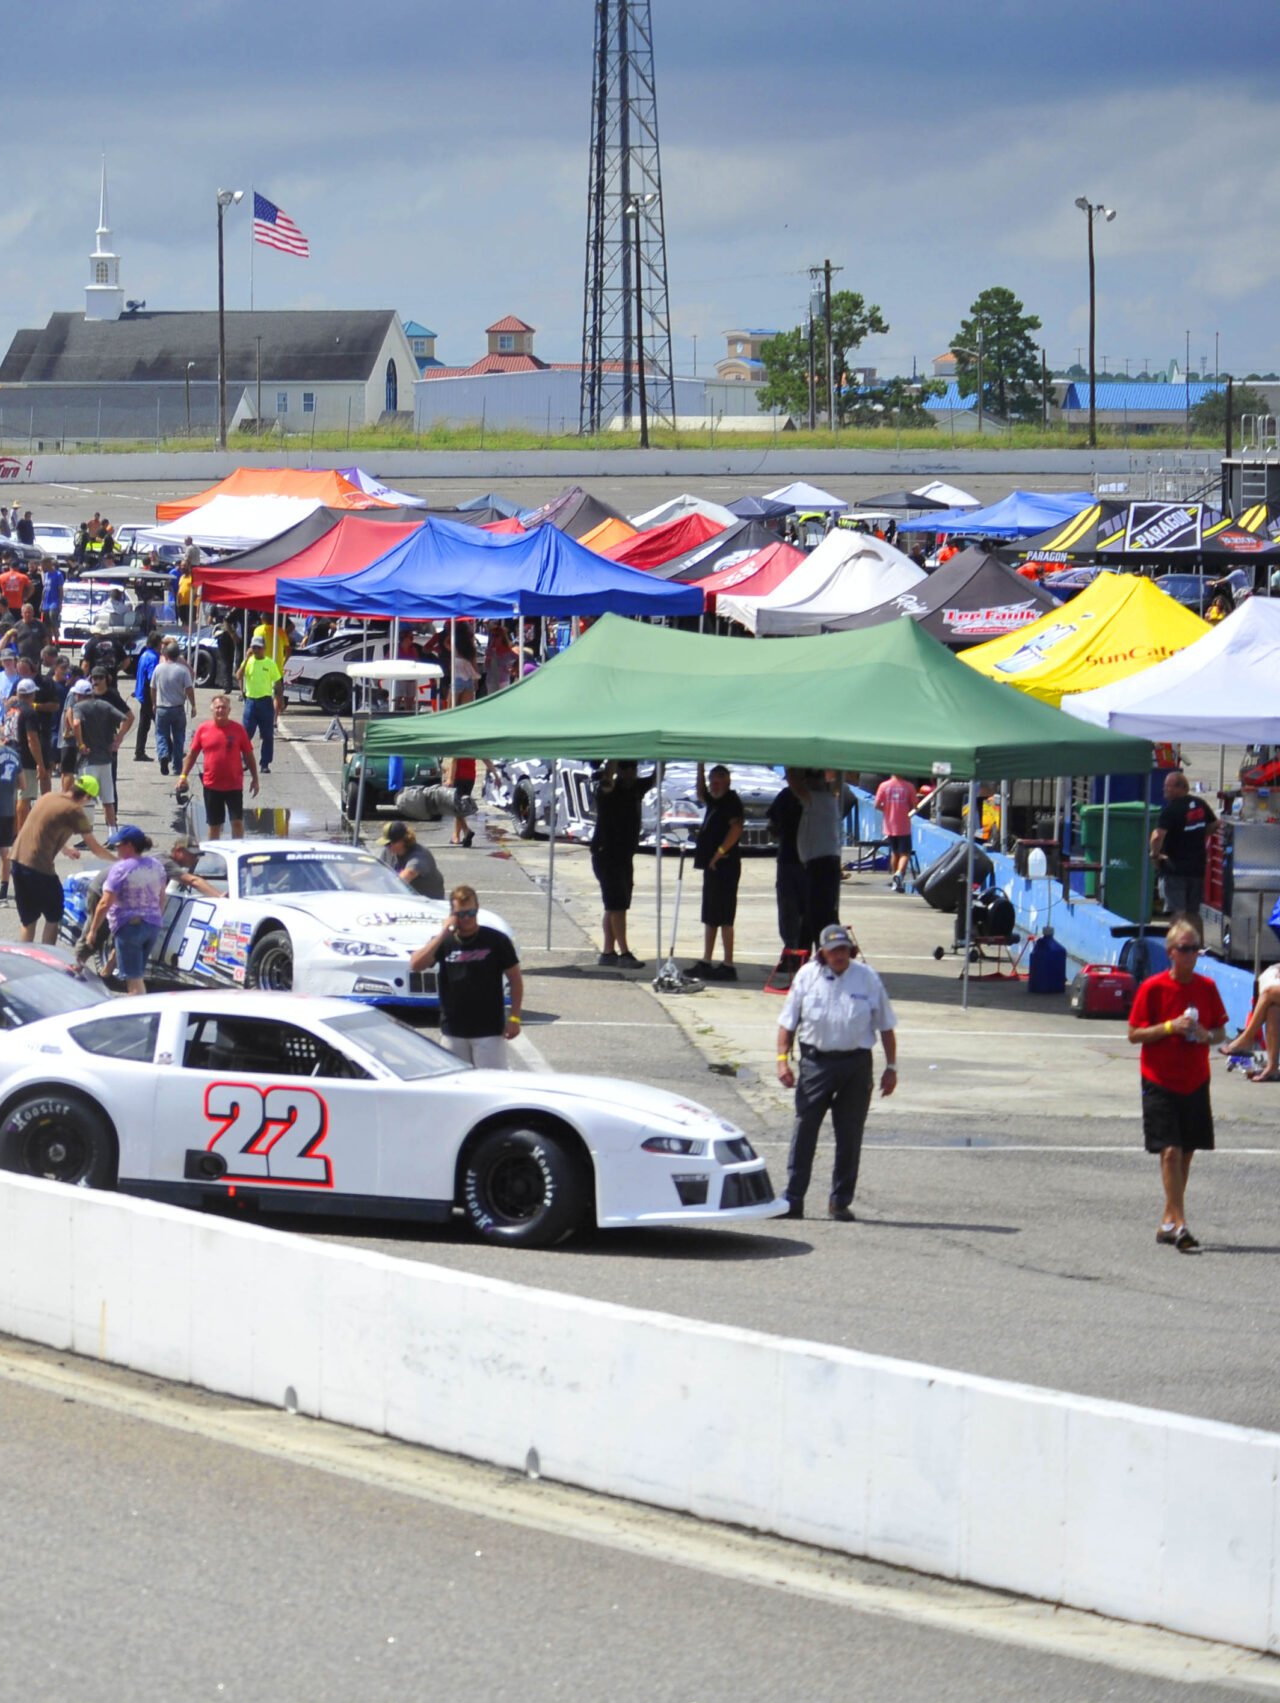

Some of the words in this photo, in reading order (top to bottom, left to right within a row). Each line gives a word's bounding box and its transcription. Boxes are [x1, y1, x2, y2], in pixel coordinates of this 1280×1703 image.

[25, 460, 33, 478] 4
[1135, 508, 1193, 548] PARAGON
[1026, 550, 1068, 562] PARAGON
[945, 609, 981, 622] Lee
[984, 609, 1039, 622] Faulk
[11, 1100, 70, 1132] Hoosier
[204, 1081, 334, 1188] 22
[465, 1169, 493, 1229] Hoosier
